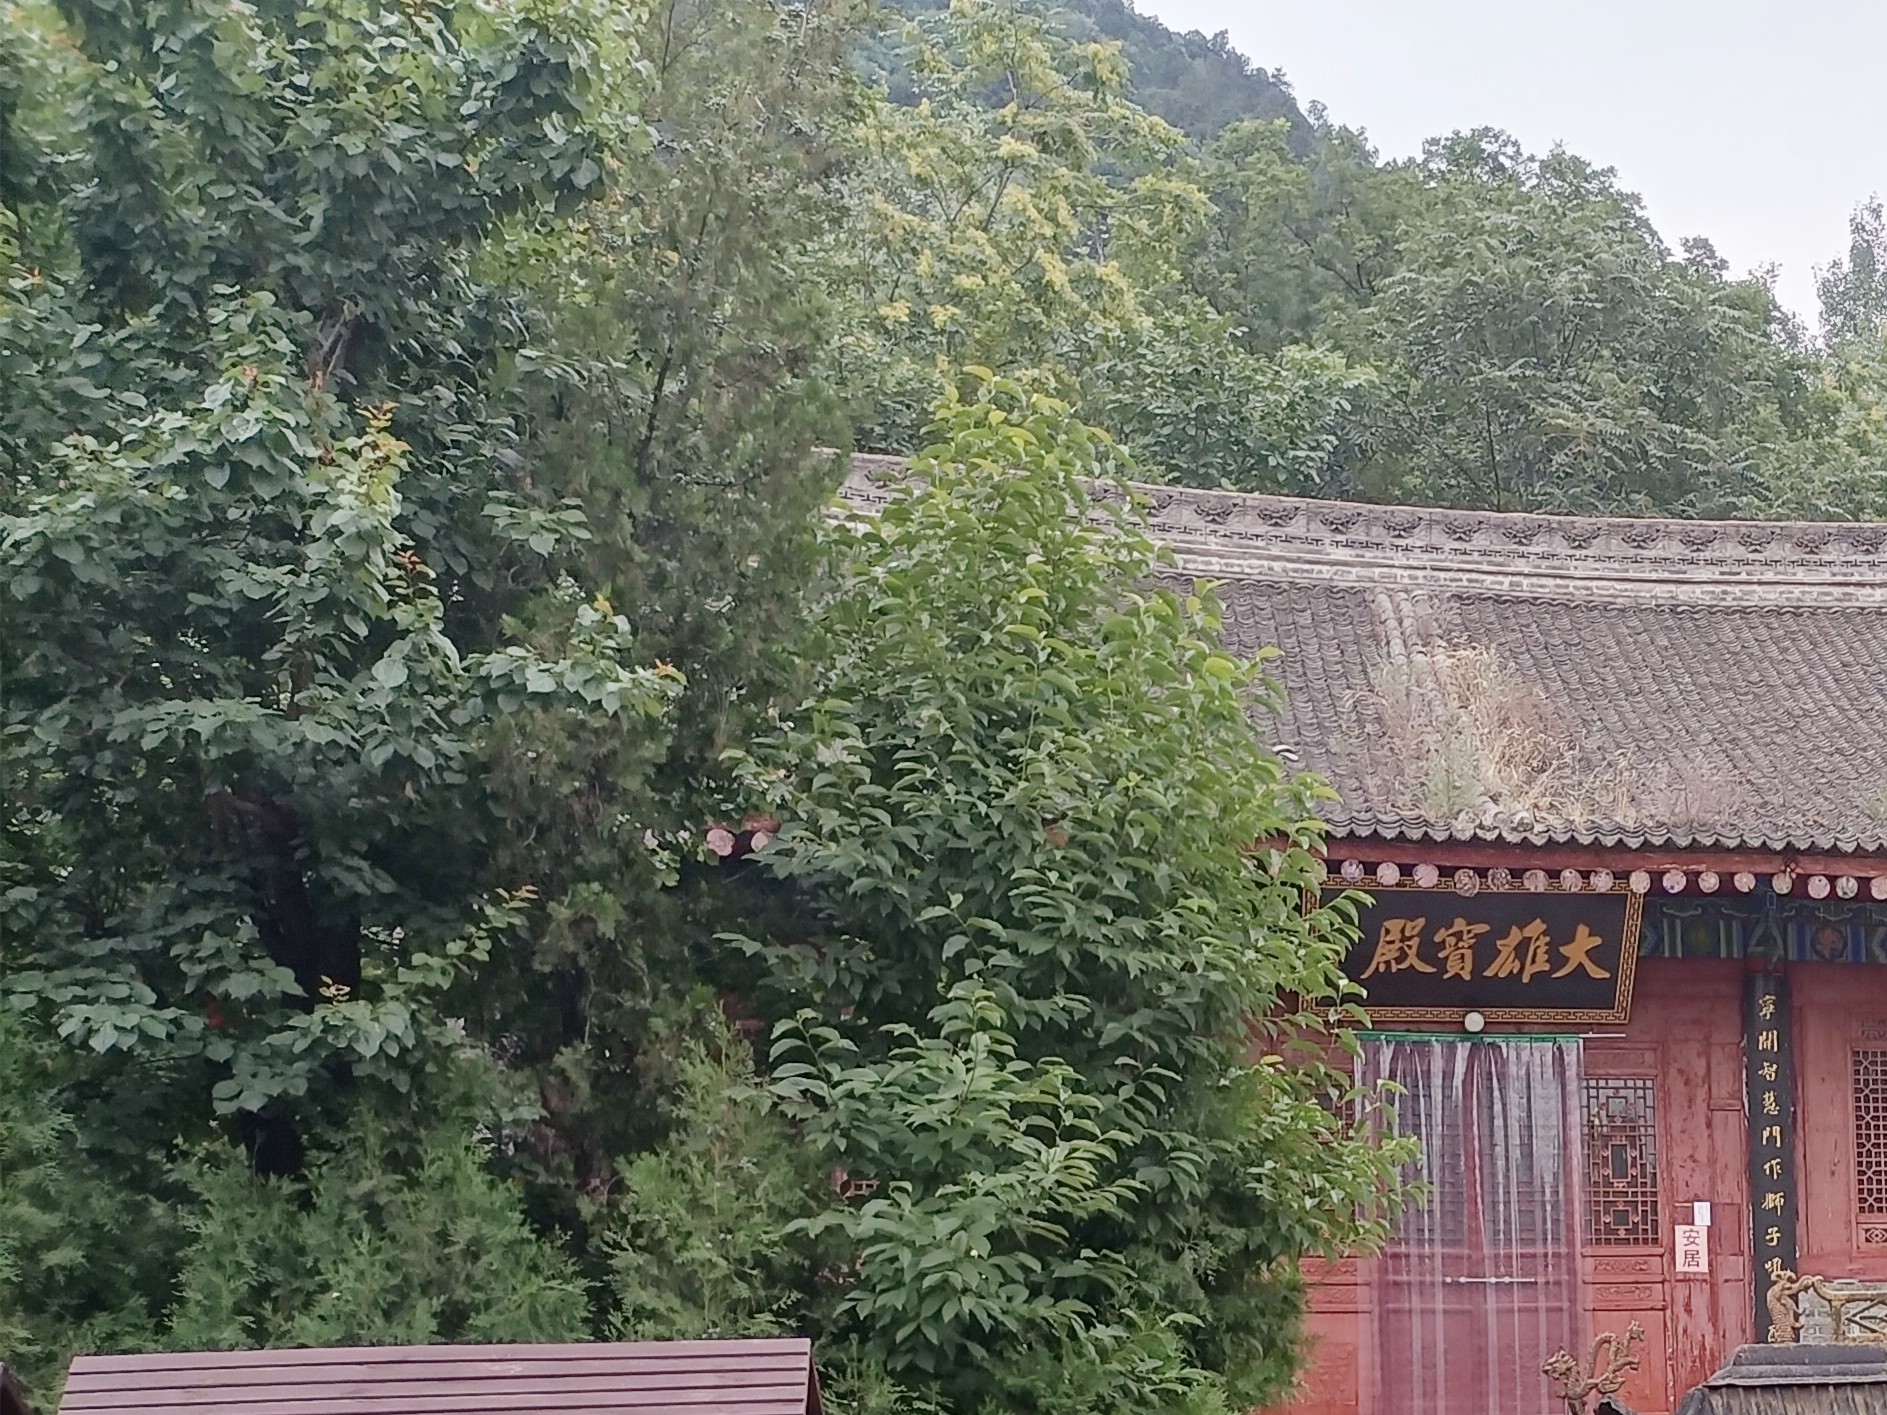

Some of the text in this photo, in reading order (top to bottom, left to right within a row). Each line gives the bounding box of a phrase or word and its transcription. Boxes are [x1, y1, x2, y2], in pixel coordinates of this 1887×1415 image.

[1359, 916, 1612, 984] 大雄寶殿
[1682, 1228, 1701, 1269] 安居
